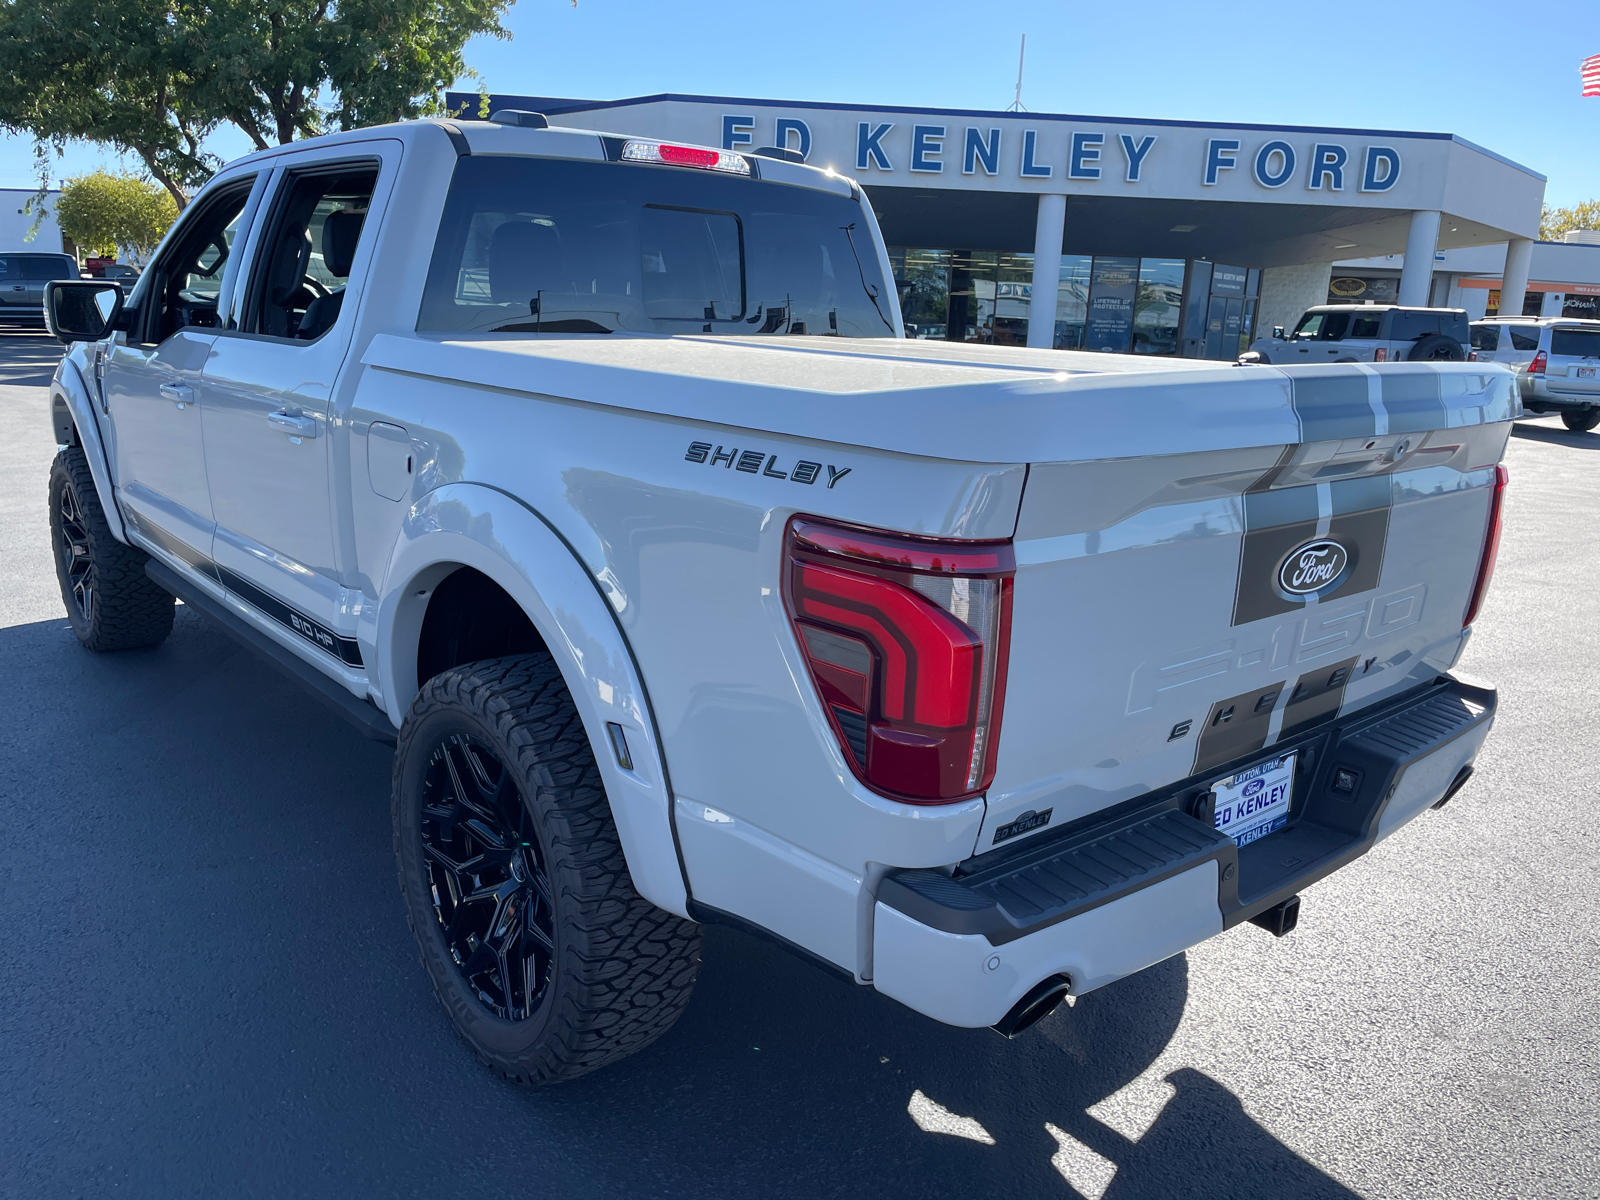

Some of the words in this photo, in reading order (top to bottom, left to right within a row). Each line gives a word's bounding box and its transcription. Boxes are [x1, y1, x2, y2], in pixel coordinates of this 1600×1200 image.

[855, 121, 1158, 182] KENLEY
[1203, 138, 1402, 193] FORD
[685, 441, 852, 489] SHELBY
[1292, 549, 1338, 586] Ford
[290, 613, 314, 637] 810
[314, 627, 334, 646] HP
[1125, 582, 1429, 716] F-150
[1262, 759, 1280, 773] UTAH
[1214, 806, 1232, 828] ED
[1236, 783, 1288, 820] KENLEY
[1245, 781, 1262, 796] Ford
[994, 829, 1009, 841] ED
[1010, 812, 1051, 835] KENLEY
[1240, 821, 1274, 846] KENLEY
